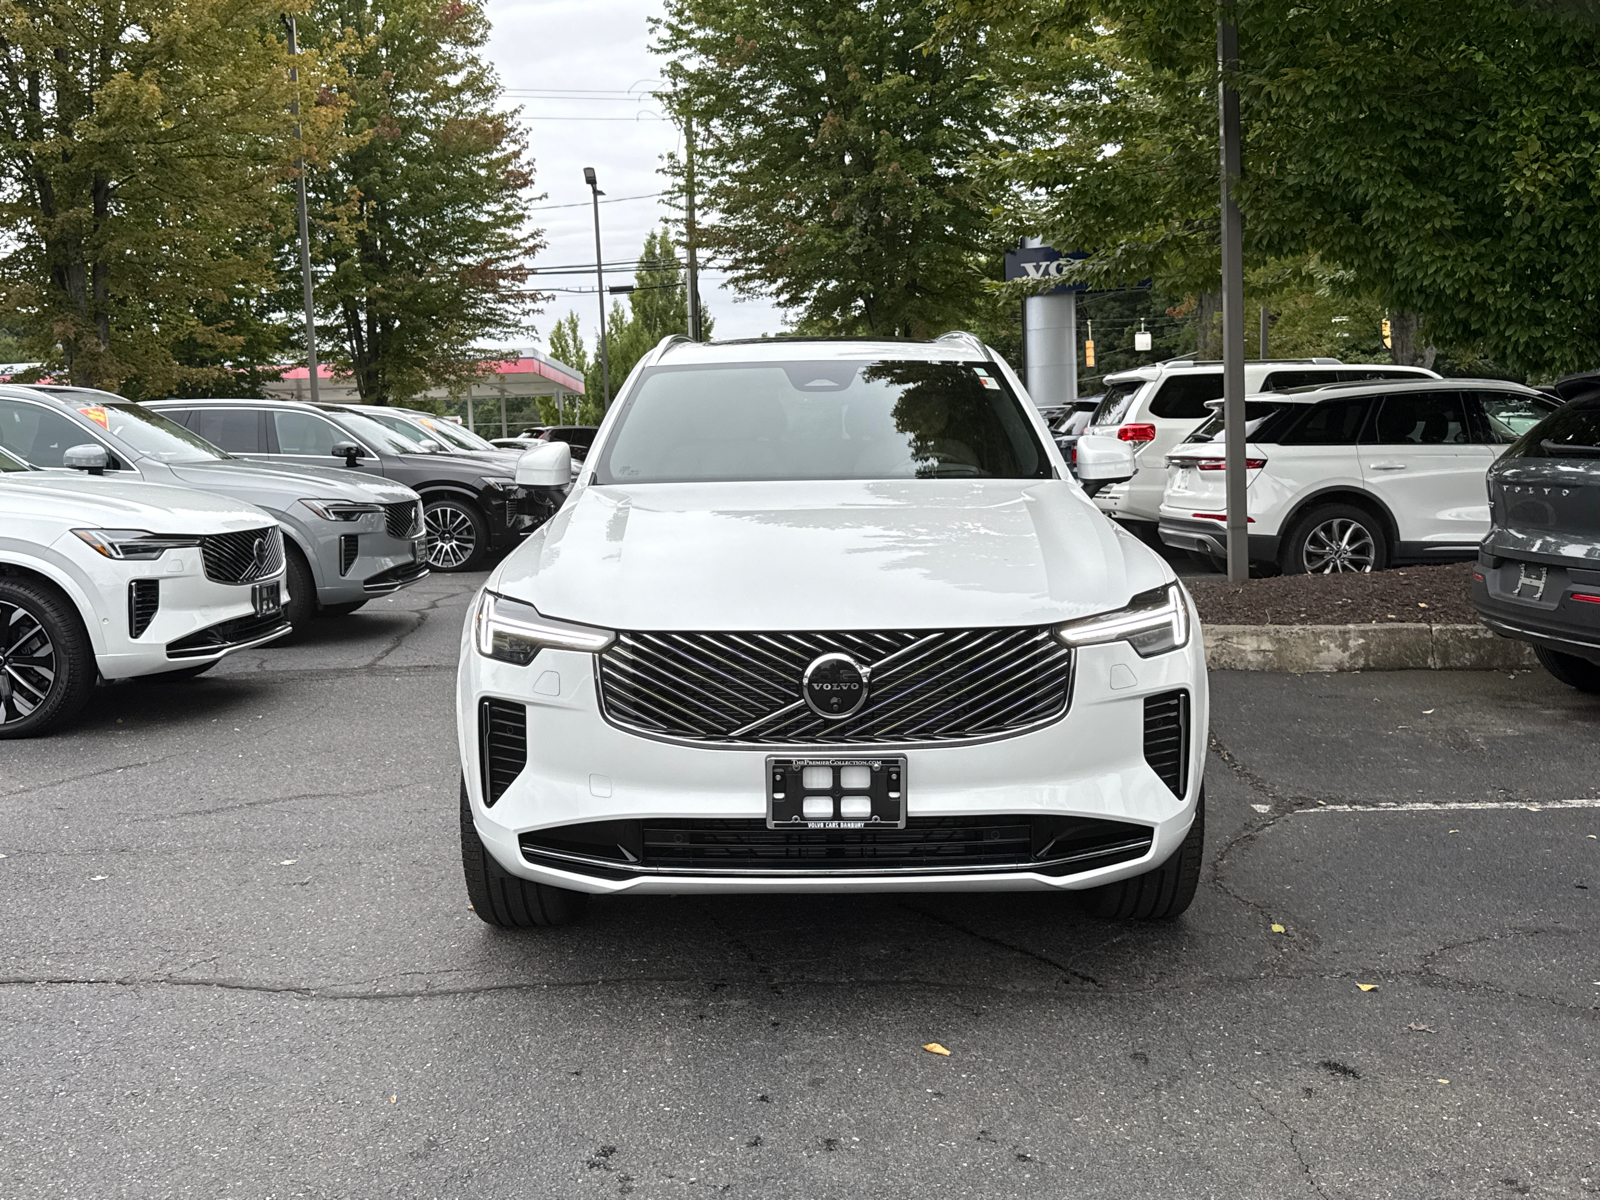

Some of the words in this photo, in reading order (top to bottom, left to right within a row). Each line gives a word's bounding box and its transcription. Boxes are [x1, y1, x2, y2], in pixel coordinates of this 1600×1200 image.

[811, 682, 860, 691] VOLVO
[807, 821, 824, 829] VOLVO
[825, 821, 839, 829] CARS
[840, 821, 865, 829] DANBURY
